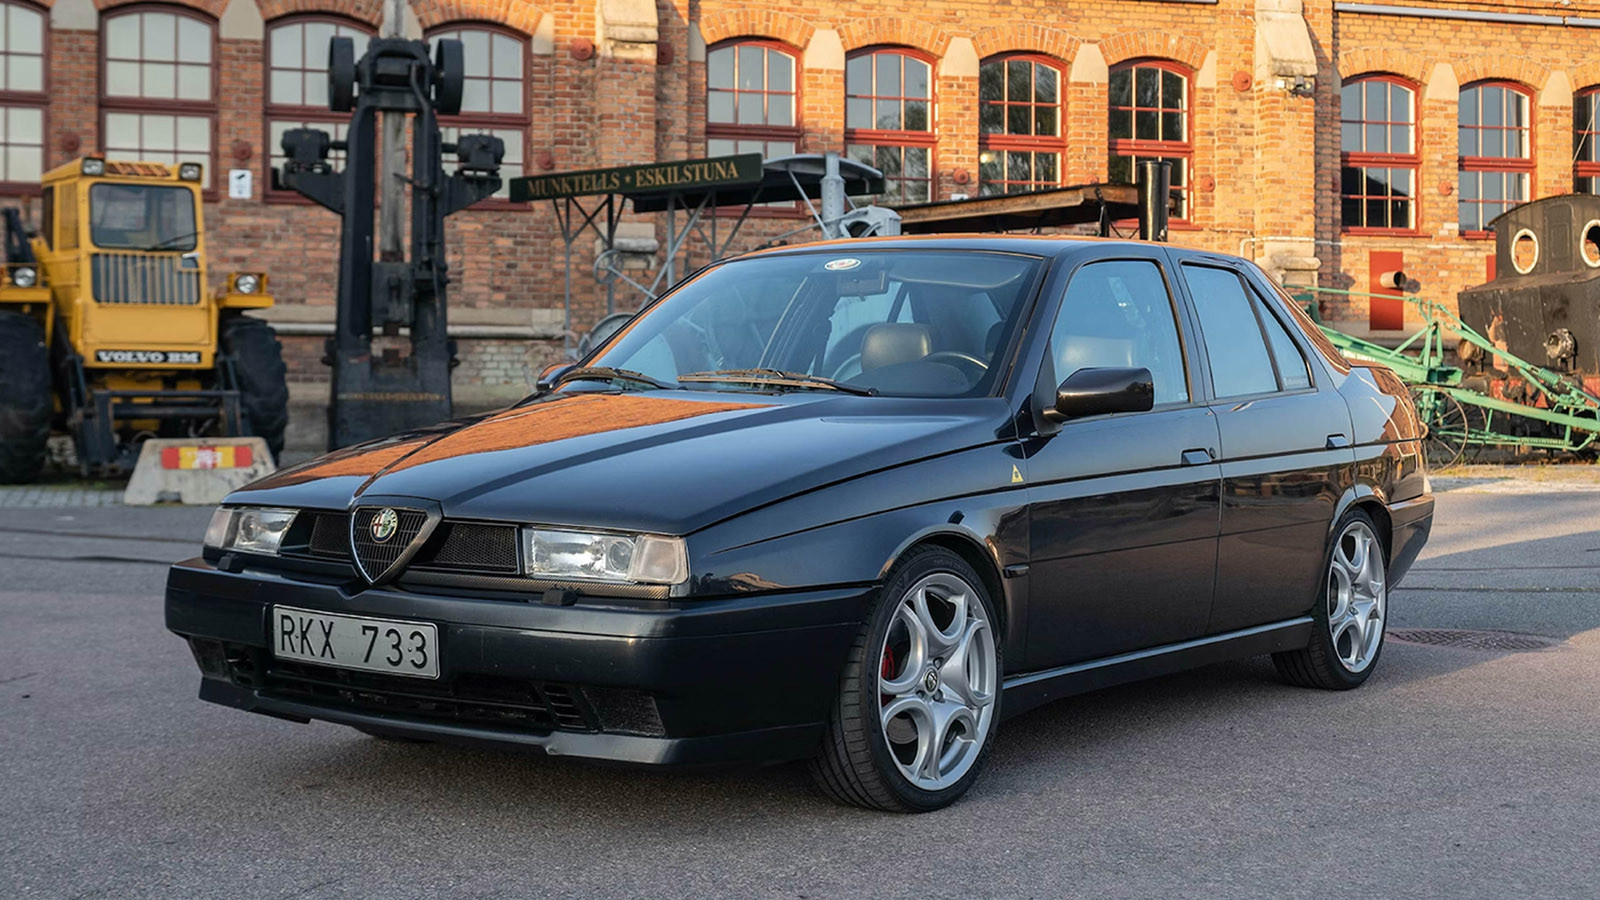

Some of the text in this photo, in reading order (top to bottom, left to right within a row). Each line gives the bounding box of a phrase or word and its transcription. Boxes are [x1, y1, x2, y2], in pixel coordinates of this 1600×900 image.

[527, 160, 739, 197] MUNKTELLS ESKILSTUNA
[98, 351, 165, 363] VOLVO
[280, 614, 428, 669] RKX 733
